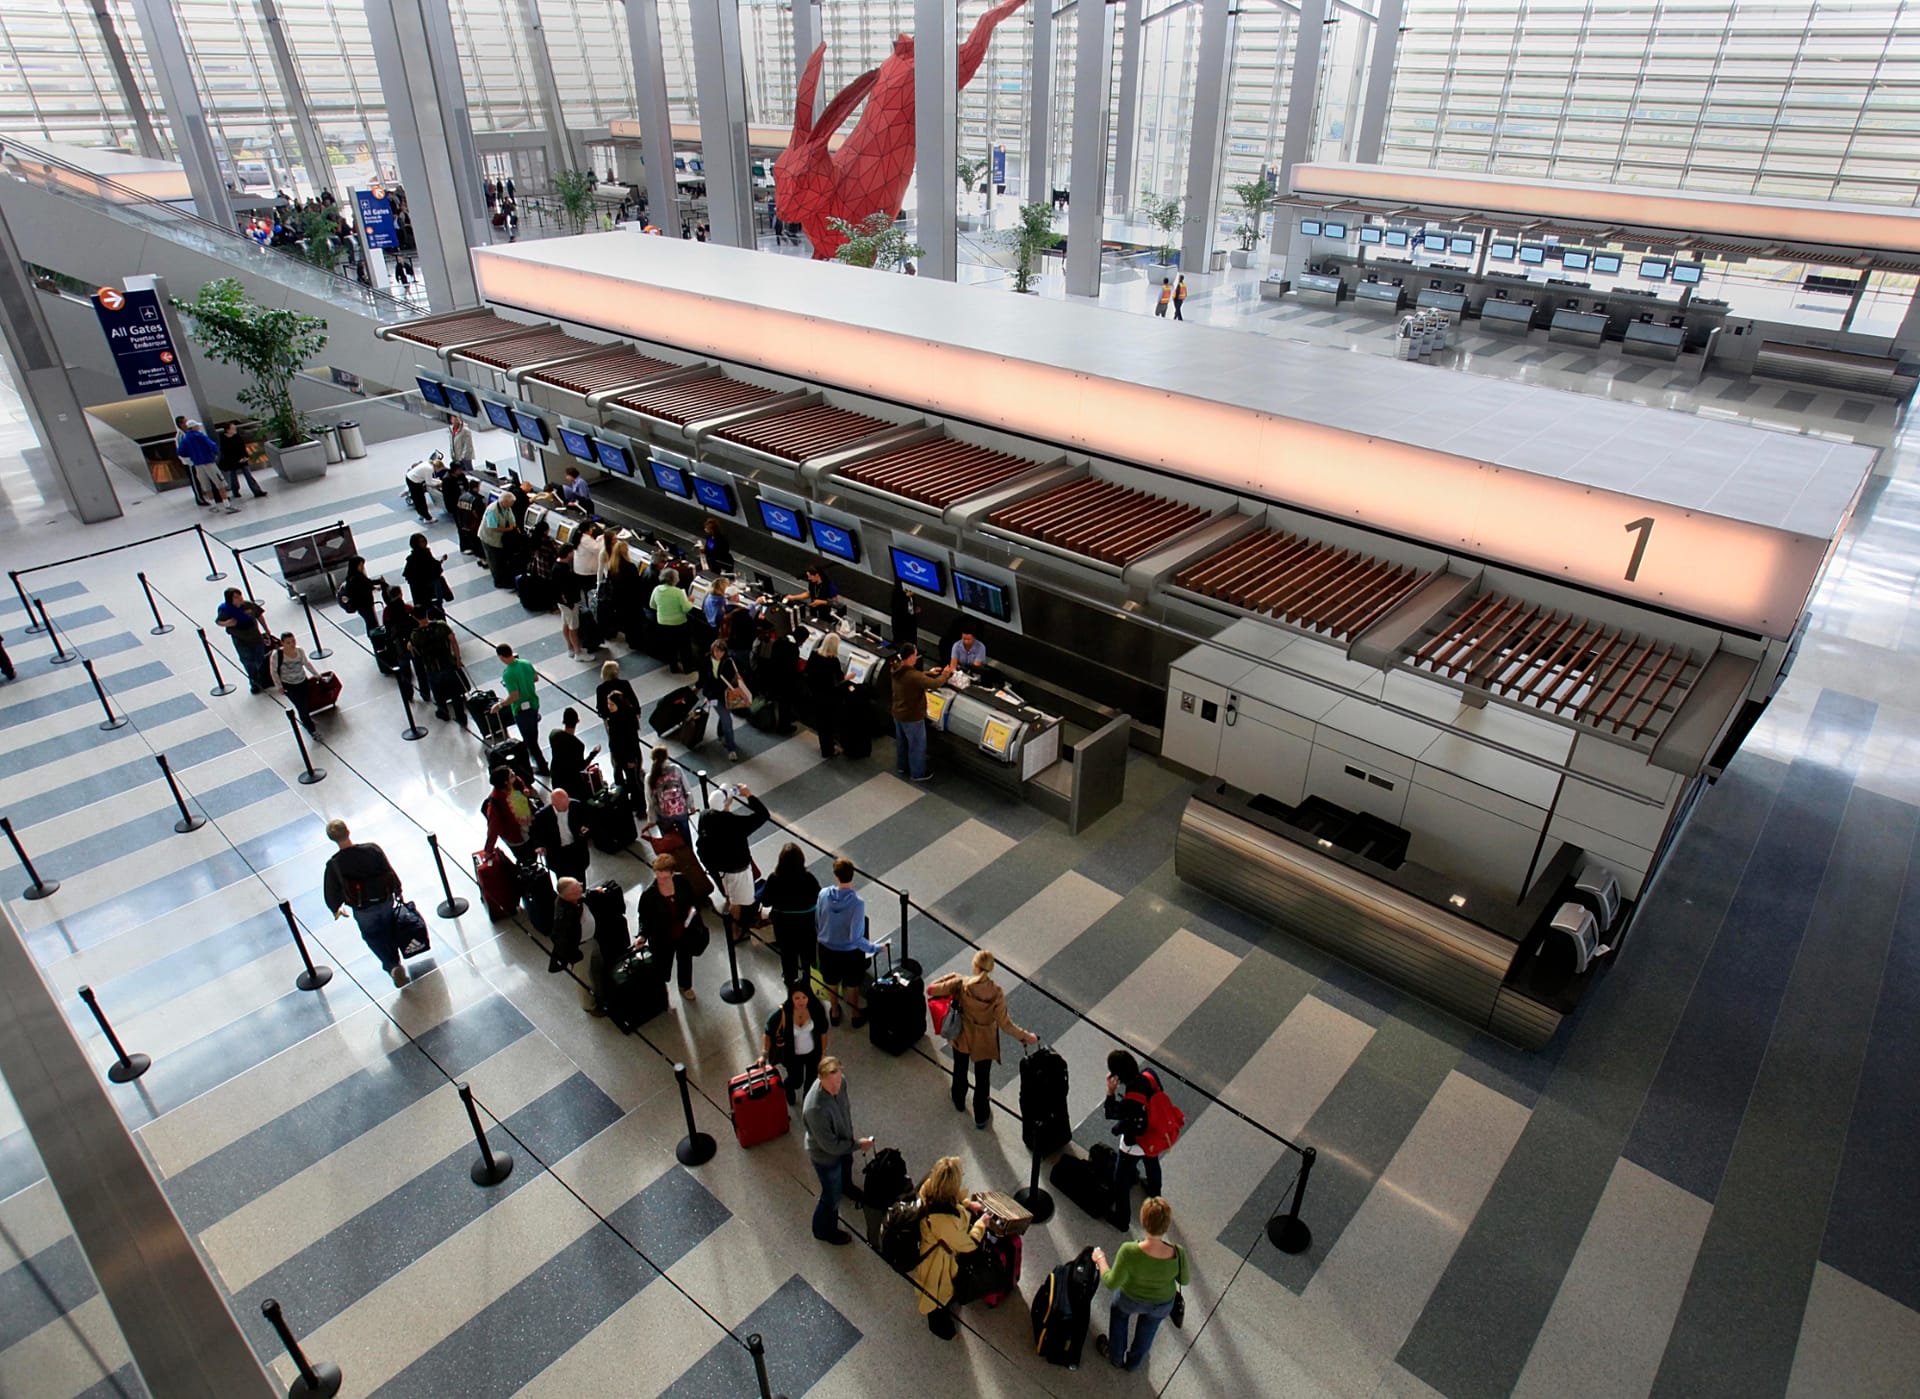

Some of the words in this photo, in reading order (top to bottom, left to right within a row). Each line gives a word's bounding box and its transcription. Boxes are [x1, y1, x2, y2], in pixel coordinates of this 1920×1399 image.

[111, 327, 127, 338] All
[129, 324, 163, 335] Gates
[130, 335, 155, 343] Puertas
[133, 339, 167, 349] Embarque
[1624, 516, 1655, 582] 1
